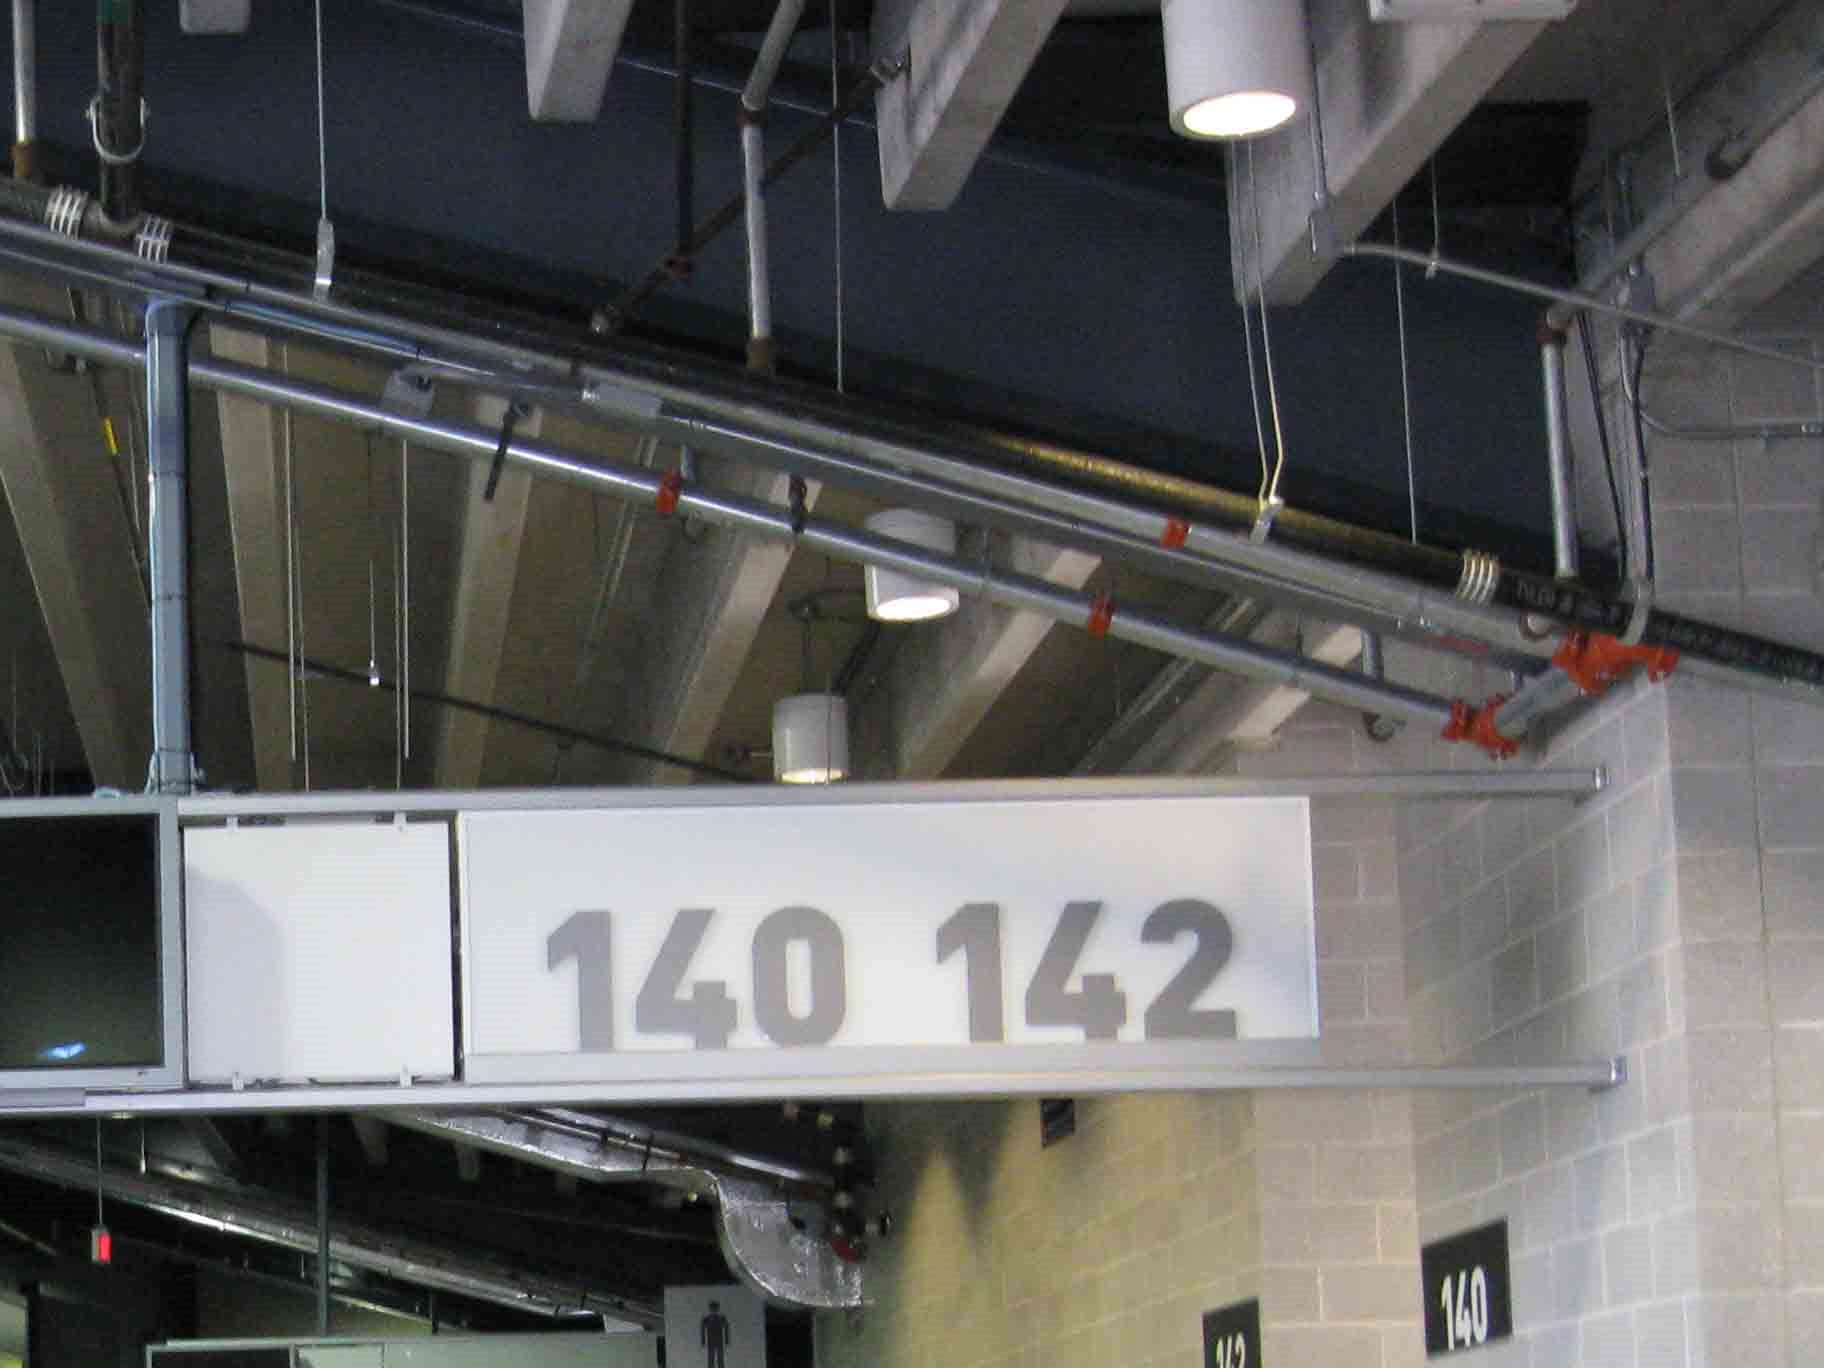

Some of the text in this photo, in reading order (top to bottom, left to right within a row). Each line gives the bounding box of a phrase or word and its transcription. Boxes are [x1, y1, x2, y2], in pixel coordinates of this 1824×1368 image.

[547, 898, 1239, 1050] 140 142
[1441, 1265, 1488, 1351] 140
